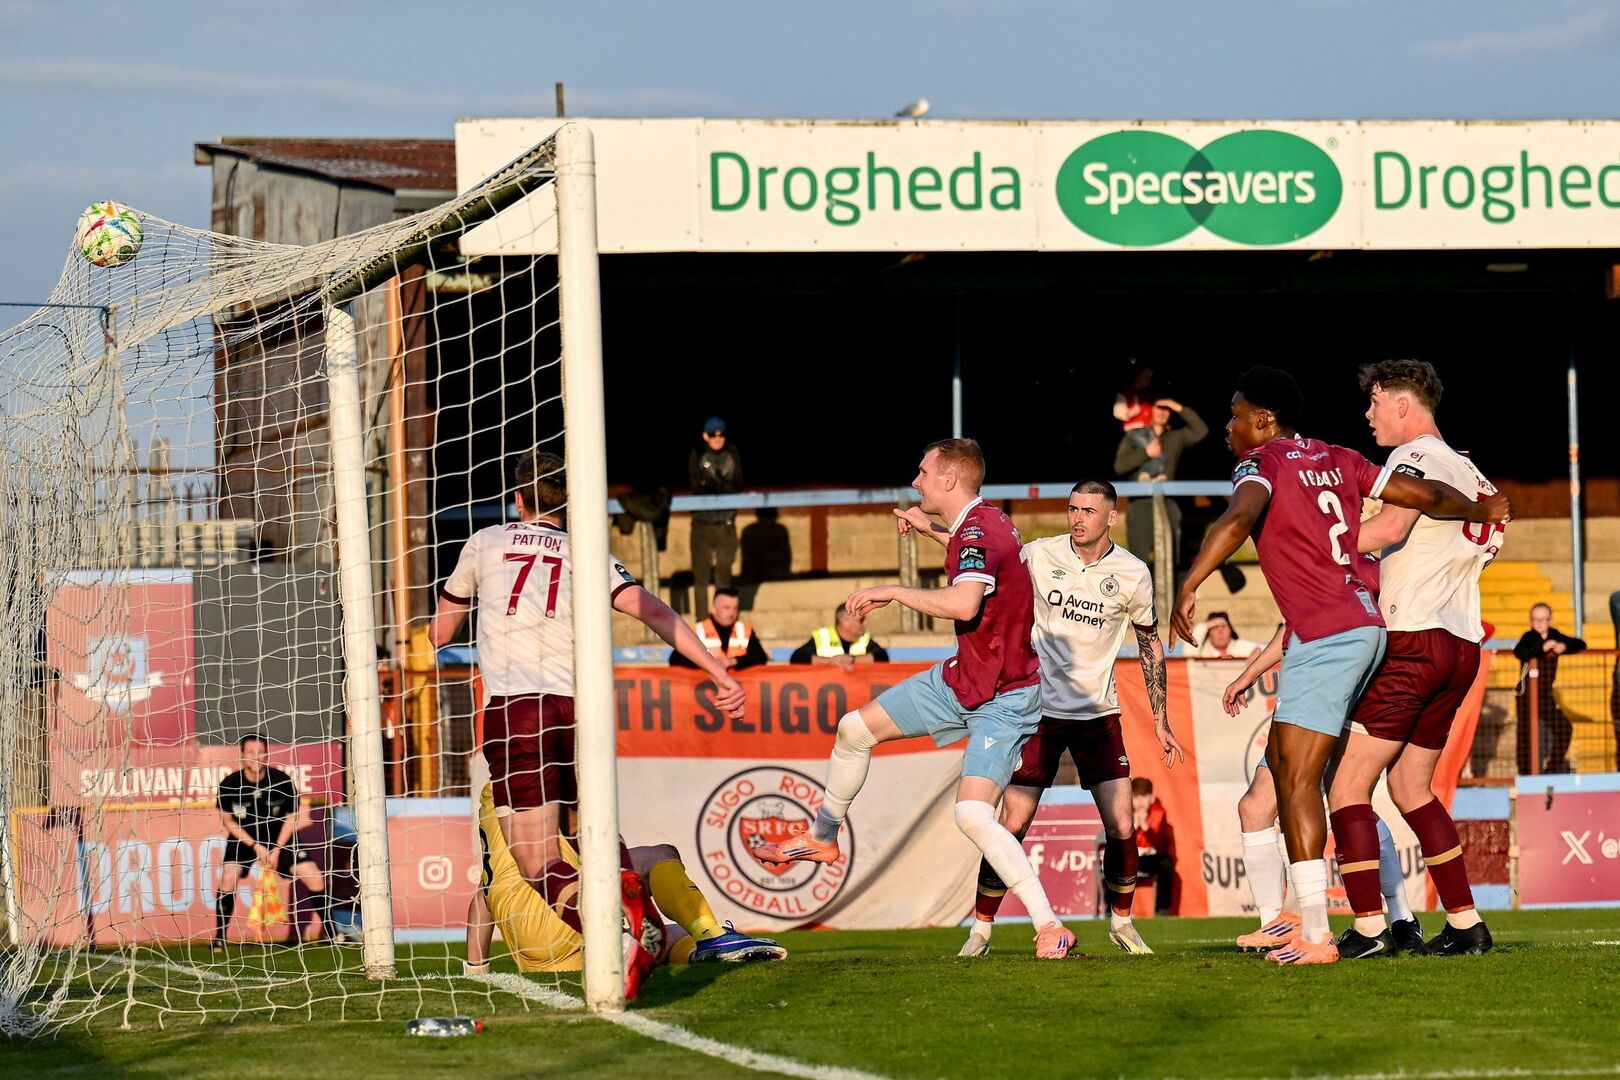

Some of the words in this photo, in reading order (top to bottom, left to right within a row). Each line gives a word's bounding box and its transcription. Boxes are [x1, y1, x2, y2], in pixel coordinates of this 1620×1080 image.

[710, 150, 1022, 226] Drogheda
[1082, 162, 1317, 215] Specsavers
[512, 533, 562, 552] PATTON
[1317, 490, 1351, 566] 2
[1061, 607, 1107, 630] Money
[1064, 594, 1105, 614] Avant
[79, 766, 183, 797] SULLIVAN
[706, 779, 755, 829] SLIGO
[77, 836, 256, 914] DROG
[707, 850, 807, 914] FOOTBALL
[811, 852, 848, 902] CLUB
[1203, 852, 1247, 889] SUP
[1397, 844, 1426, 879] UB
